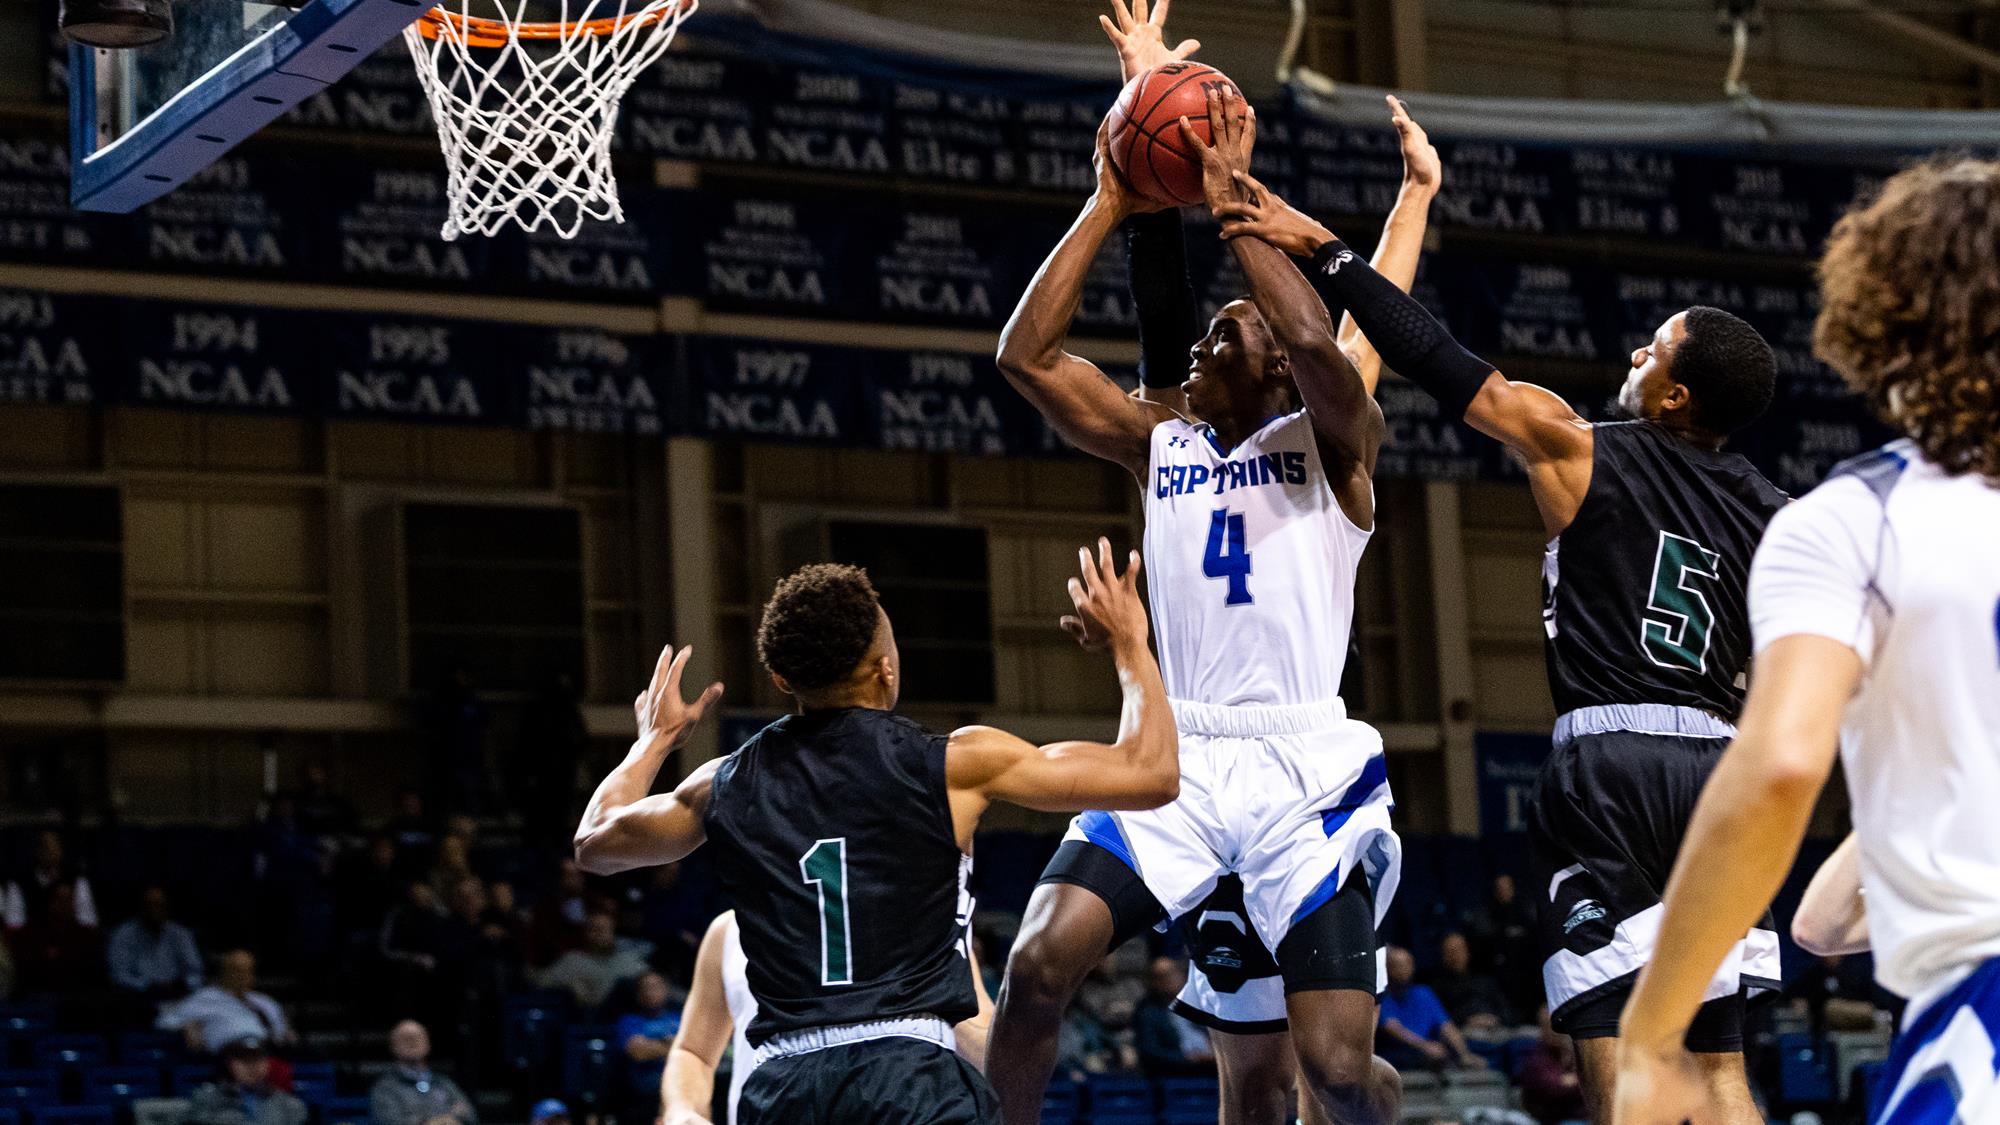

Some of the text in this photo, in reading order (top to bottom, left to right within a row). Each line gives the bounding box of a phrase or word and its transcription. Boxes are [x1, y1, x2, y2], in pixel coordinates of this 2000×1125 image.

[631, 114, 758, 161] NCAA
[766, 126, 891, 173] NCAA
[149, 222, 286, 267] NCAA
[341, 238, 471, 283] NCAA
[527, 246, 654, 290] NCAA
[706, 259, 825, 305] NCAA
[880, 274, 993, 318] NCAA
[171, 309, 259, 355] 1994
[1501, 318, 1599, 362] NCAA
[138, 356, 293, 407] NCAA
[527, 364, 660, 410] NCAA
[734, 349, 812, 387] 1997
[337, 368, 482, 417] NCAA
[703, 390, 839, 438] NCAA
[879, 387, 1000, 431] NCAA
[1156, 451, 1307, 500] CAPTAINS
[1202, 504, 1255, 608] 4
[1640, 529, 1721, 675] 5
[799, 836, 853, 987] 1
